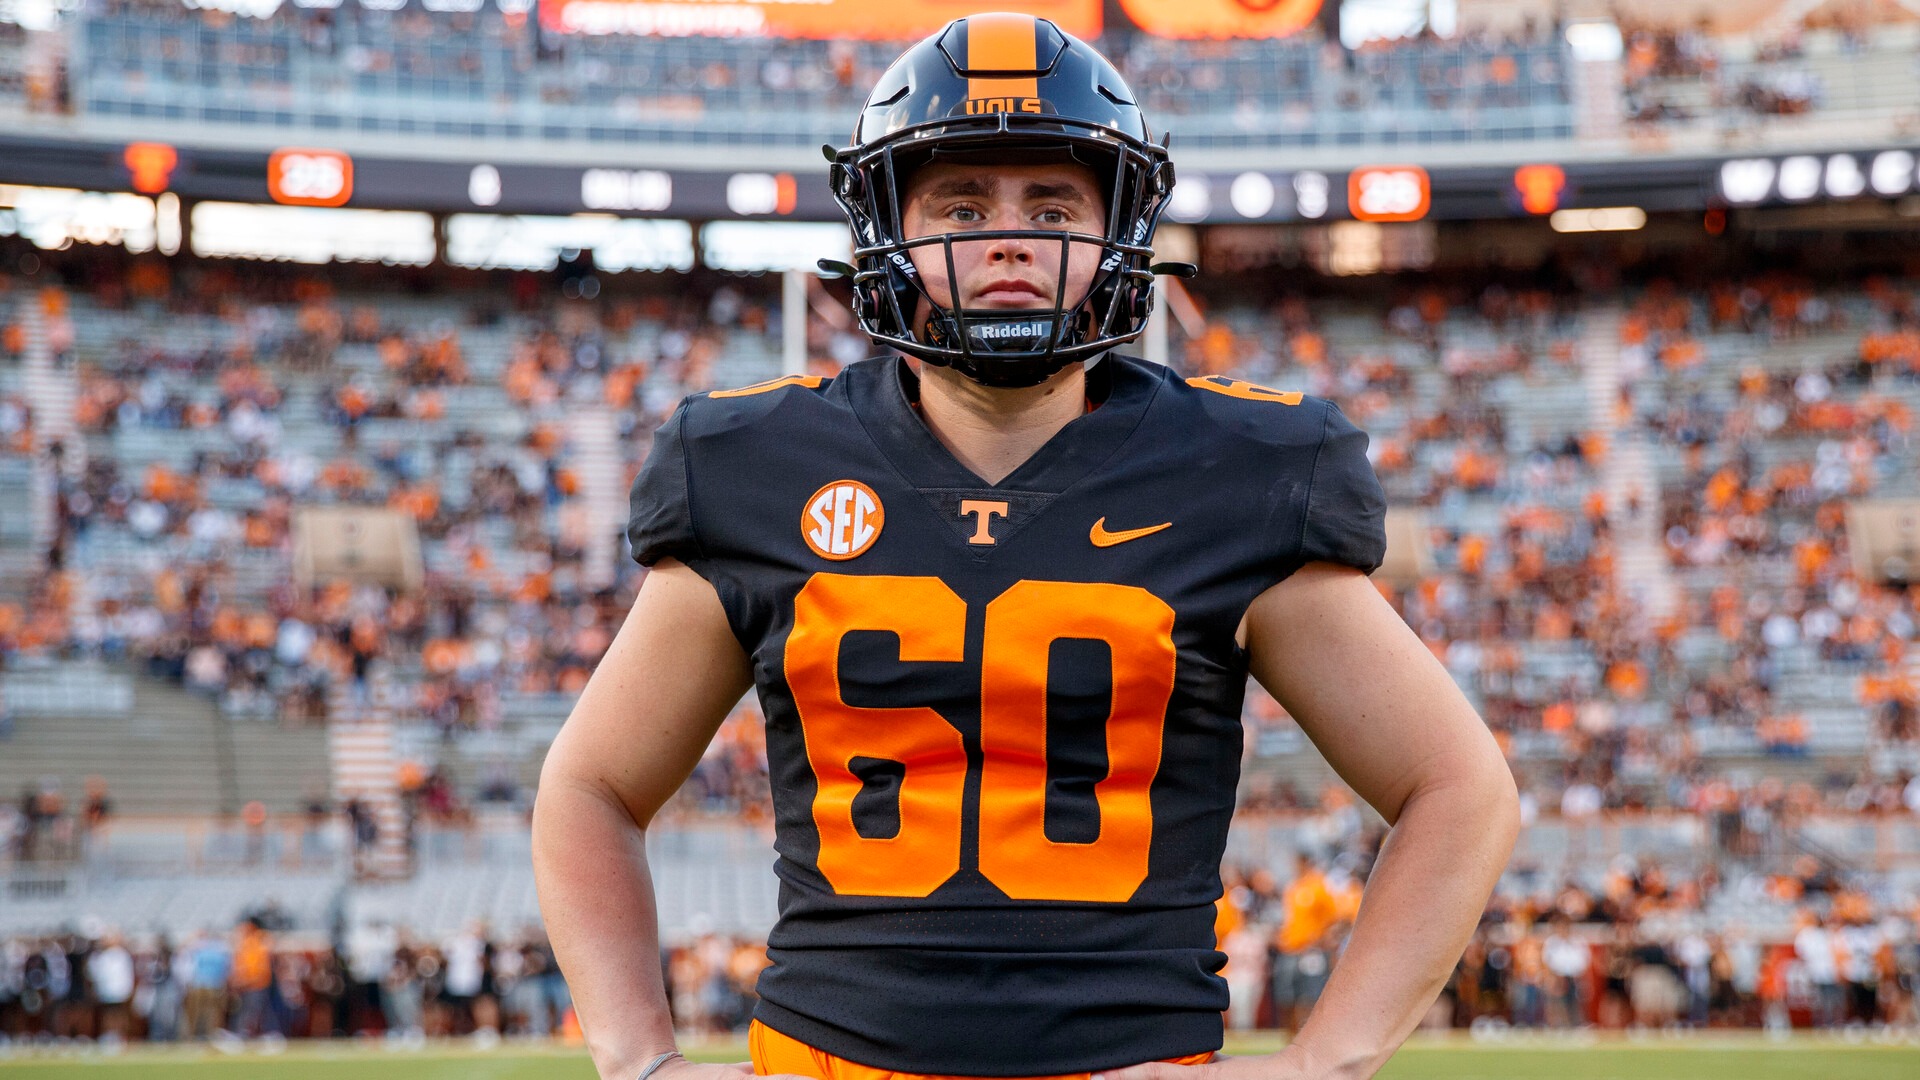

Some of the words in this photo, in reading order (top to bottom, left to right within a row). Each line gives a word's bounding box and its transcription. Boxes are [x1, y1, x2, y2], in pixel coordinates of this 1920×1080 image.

[981, 323, 1043, 339] Riddell
[809, 485, 877, 555] SEC
[961, 499, 1009, 544] T
[784, 572, 1177, 903] 60
